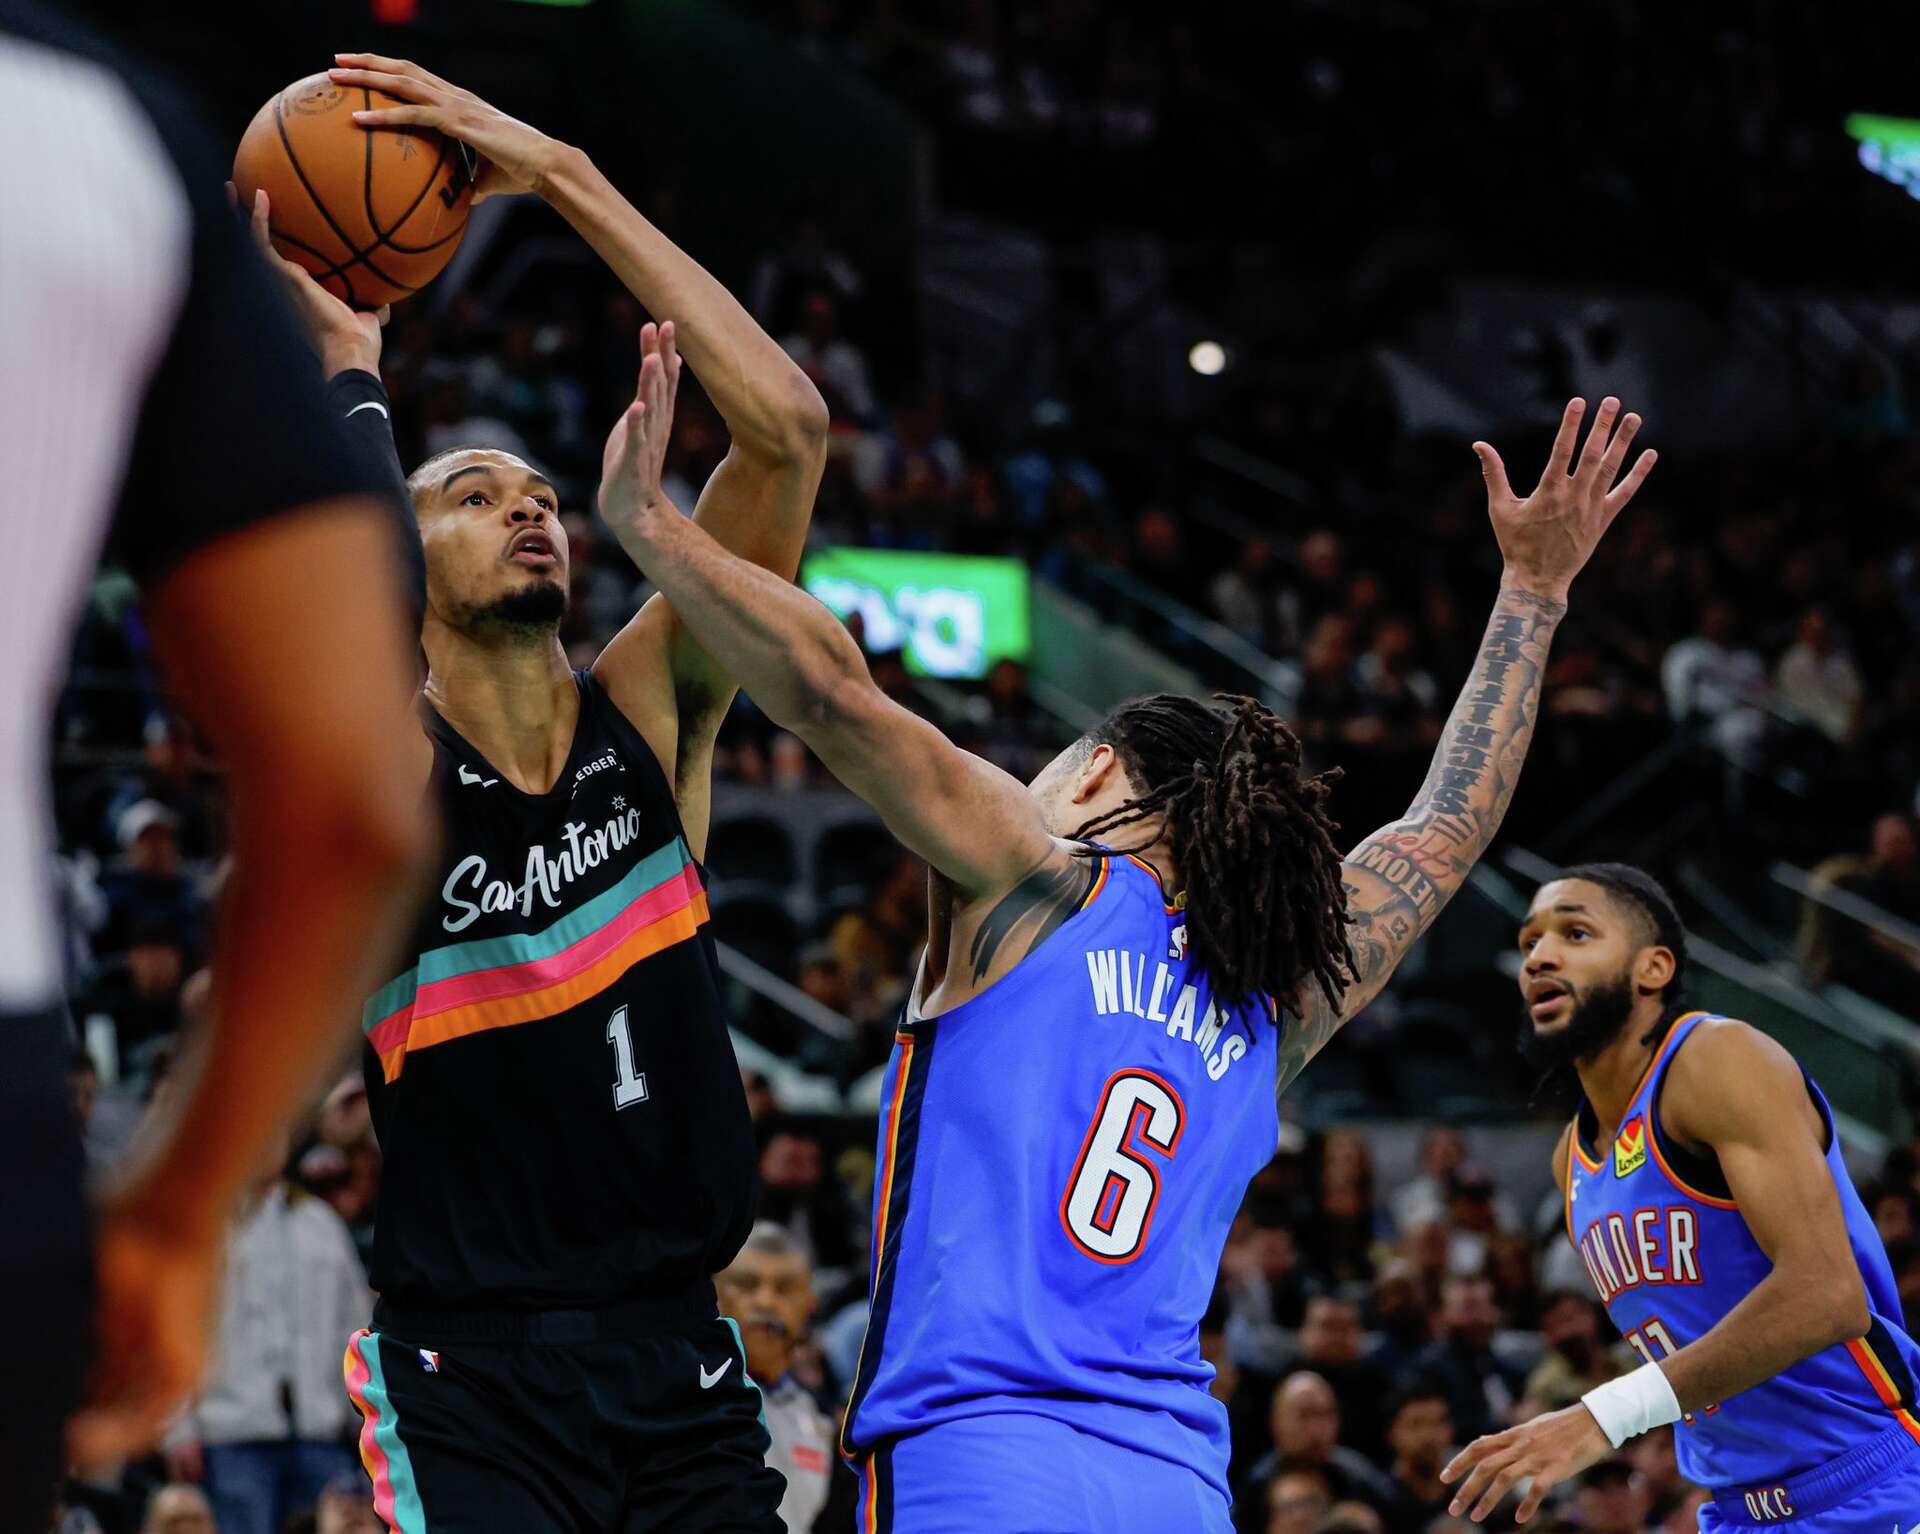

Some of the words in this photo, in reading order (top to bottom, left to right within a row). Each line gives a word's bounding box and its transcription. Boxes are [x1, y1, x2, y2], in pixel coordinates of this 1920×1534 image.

[515, 802, 641, 917] Antonio
[606, 1004, 649, 1111] 1
[1086, 949, 1248, 1082] WILLAMS
[1059, 1067, 1187, 1265] 6
[1580, 1205, 1704, 1309] UNDER
[1744, 1486, 1794, 1521] OKC
